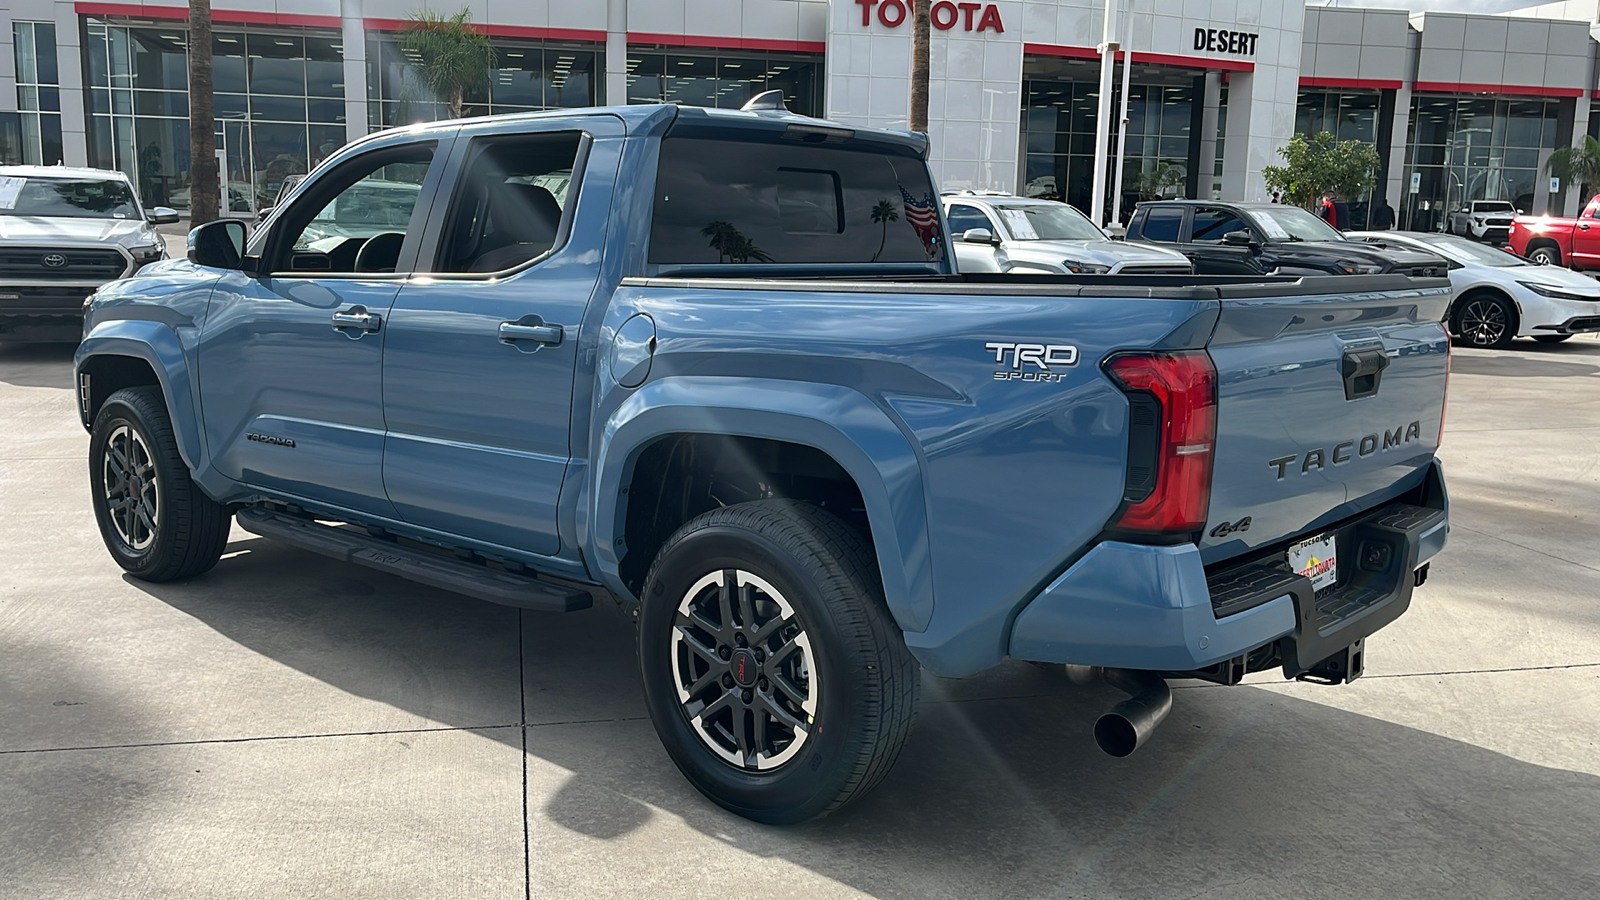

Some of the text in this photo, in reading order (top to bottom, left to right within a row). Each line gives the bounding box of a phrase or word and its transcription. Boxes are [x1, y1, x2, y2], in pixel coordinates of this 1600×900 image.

[1194, 28, 1259, 55] DESERT
[985, 342, 1079, 369] TRD
[994, 372, 1067, 383] SPORT
[245, 432, 296, 448] TACOMA
[1269, 420, 1420, 481] TACOMA
[1300, 535, 1326, 548] TUCSON
